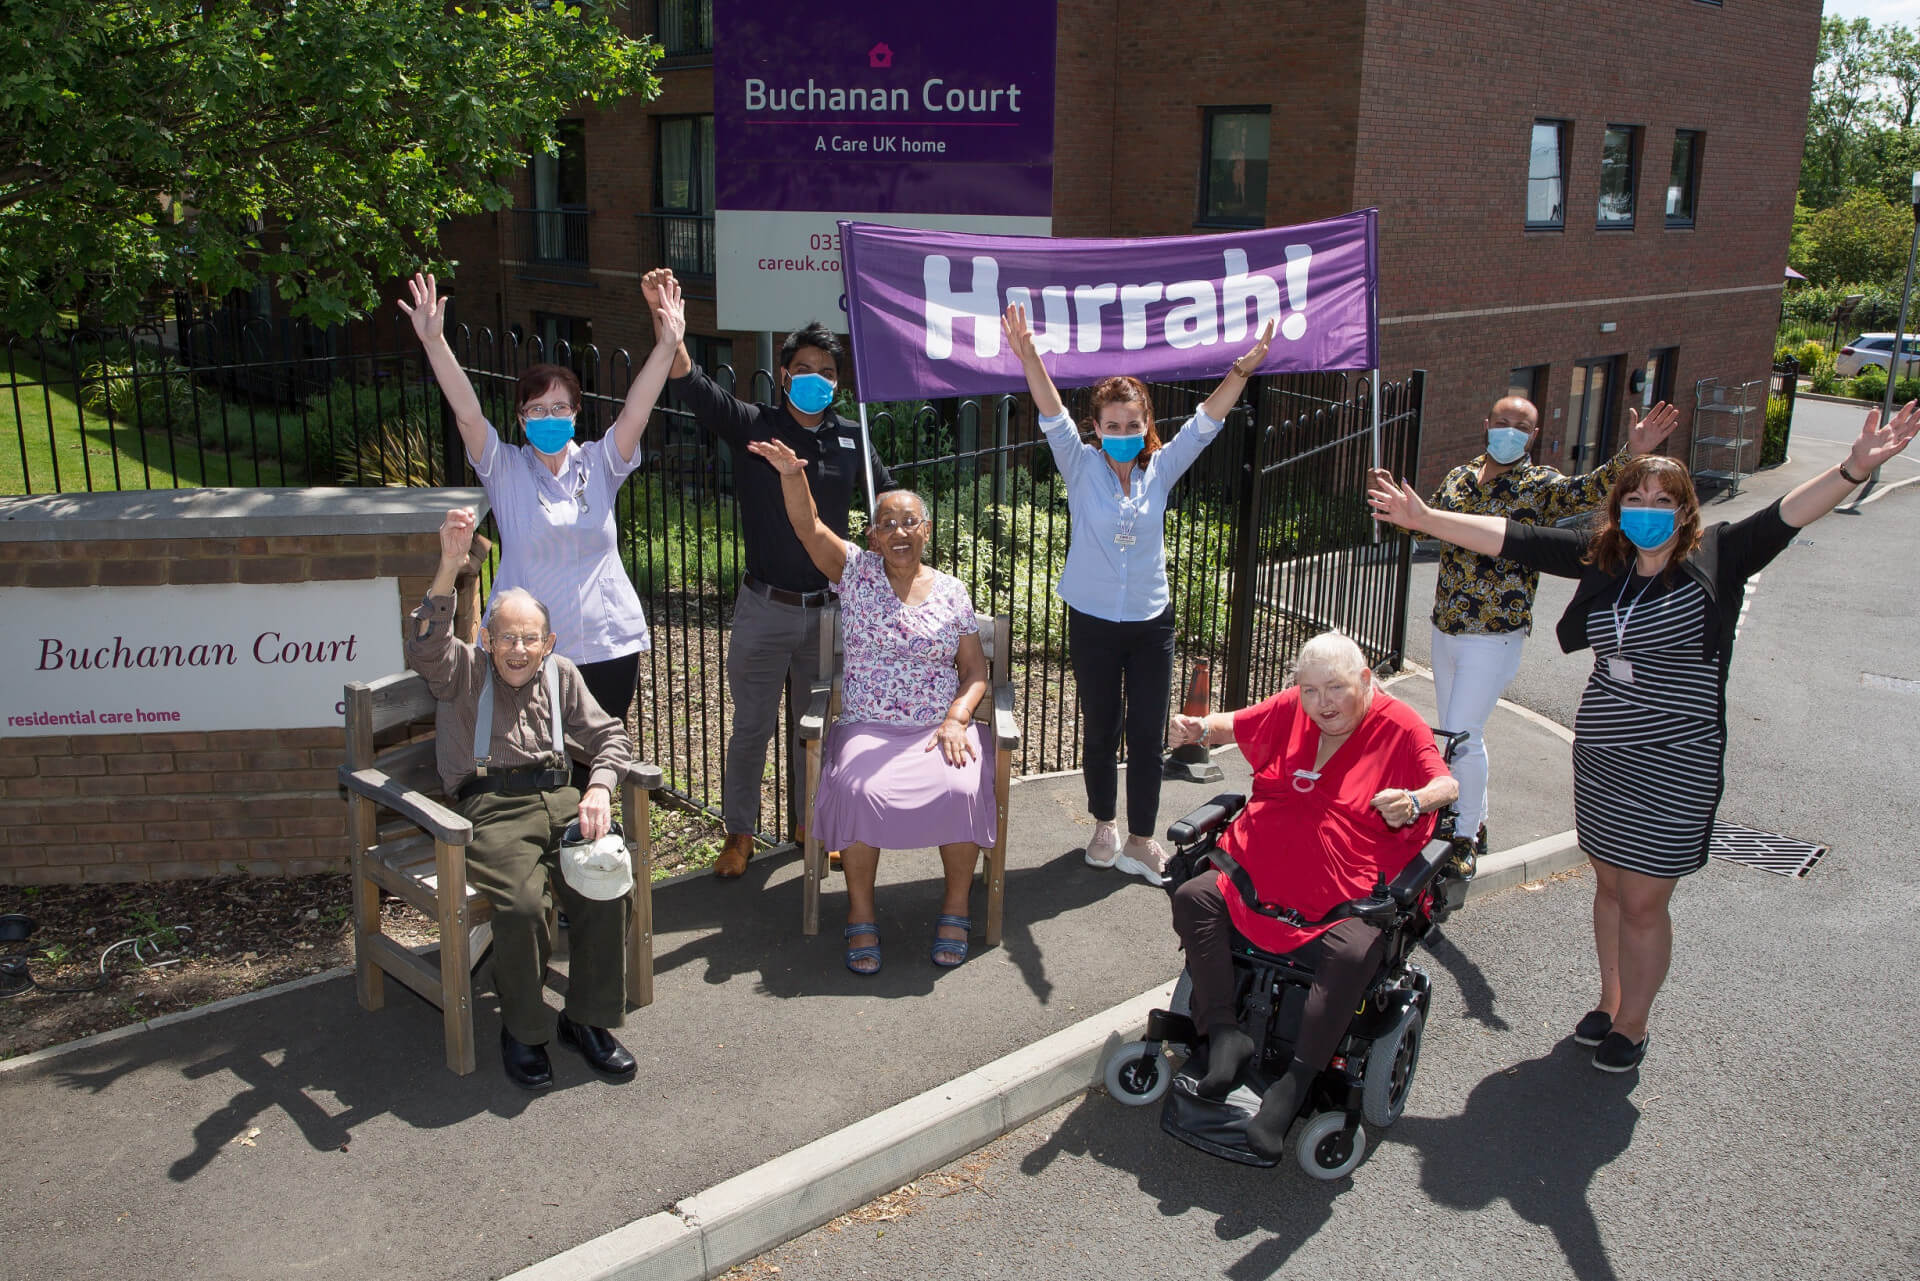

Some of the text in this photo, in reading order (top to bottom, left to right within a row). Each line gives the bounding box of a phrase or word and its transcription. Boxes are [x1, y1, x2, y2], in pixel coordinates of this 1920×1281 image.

[745, 79, 1021, 113] Buchanan Court
[815, 136, 946, 153] A Care UK home
[923, 244, 1313, 360] Hurrah!
[34, 631, 358, 672] Buchanan Court
[7, 708, 181, 727] residential care home
